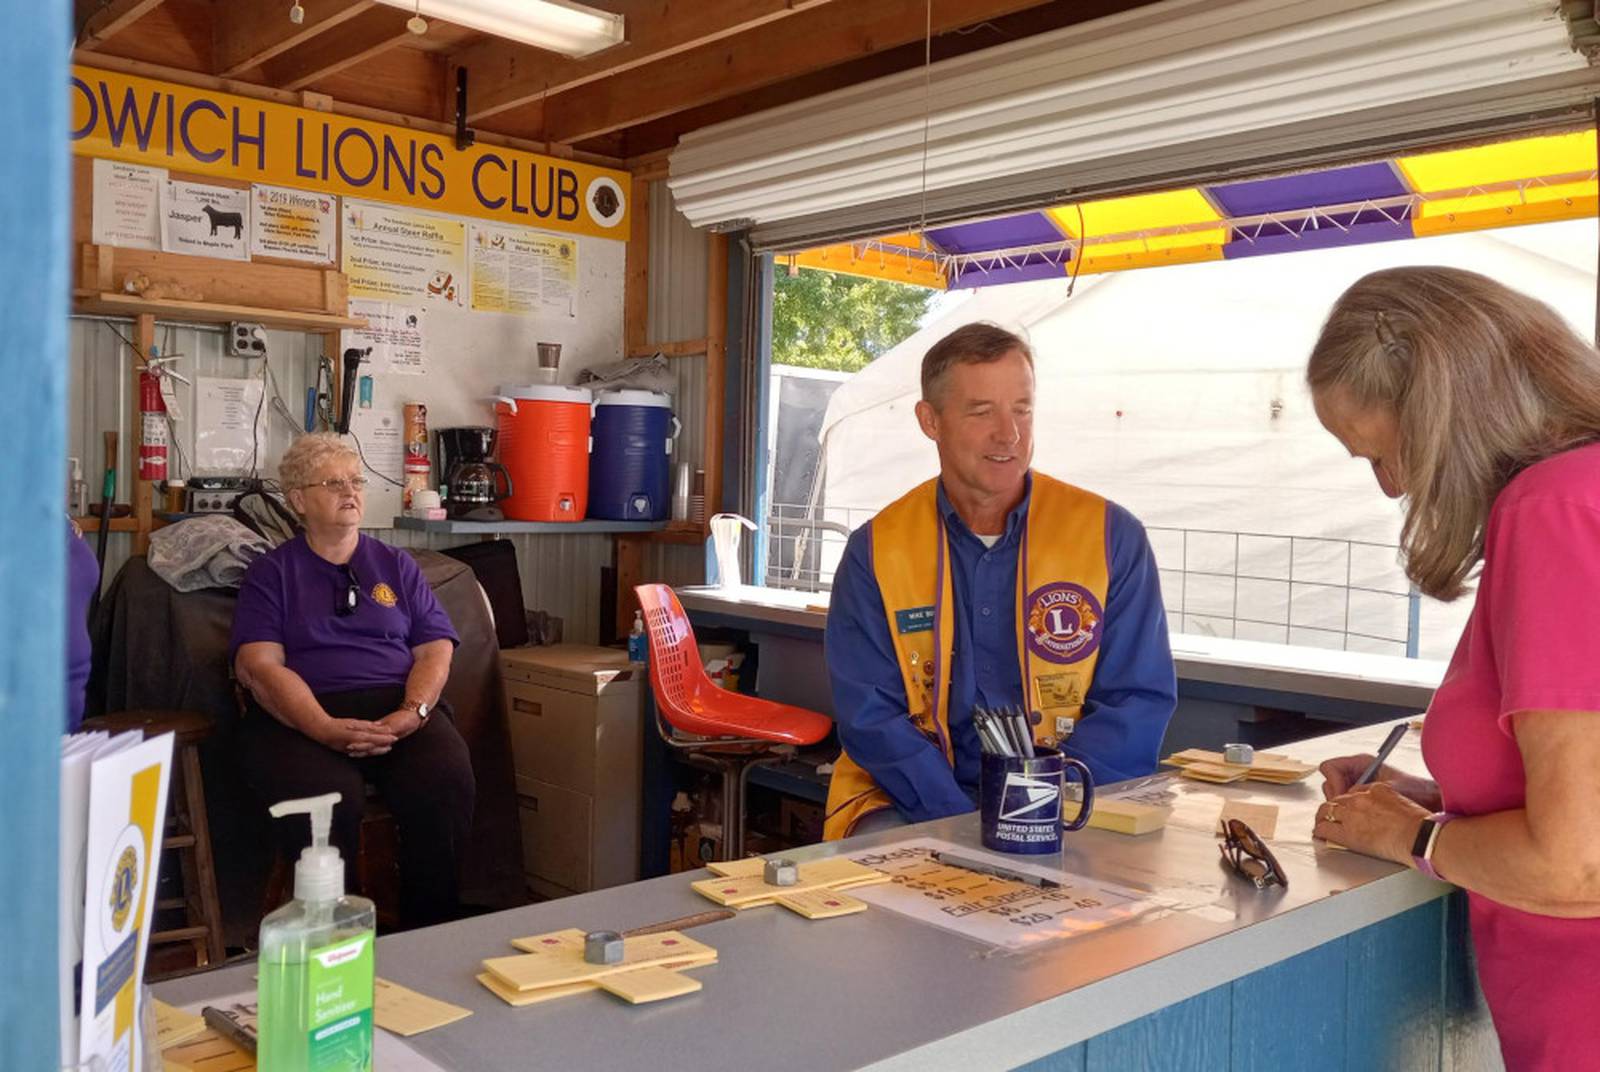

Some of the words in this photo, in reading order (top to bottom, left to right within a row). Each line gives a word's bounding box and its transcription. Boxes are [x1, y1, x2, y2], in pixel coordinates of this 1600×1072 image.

[295, 118, 446, 200] LIONS
[471, 154, 580, 221] CLUB
[289, 193, 318, 209] Winners
[168, 210, 202, 223] Jasper
[373, 222, 400, 233] Annual
[400, 226, 421, 236] Steer
[1040, 592, 1079, 608] LIONS
[1049, 608, 1074, 636] L
[998, 822, 1028, 833] UNITED
[1029, 824, 1055, 833] STATES
[996, 831, 1025, 842] POSTAL
[941, 900, 985, 917] Fair
[315, 983, 344, 1007] Hand
[314, 999, 357, 1024] Sanitizer
